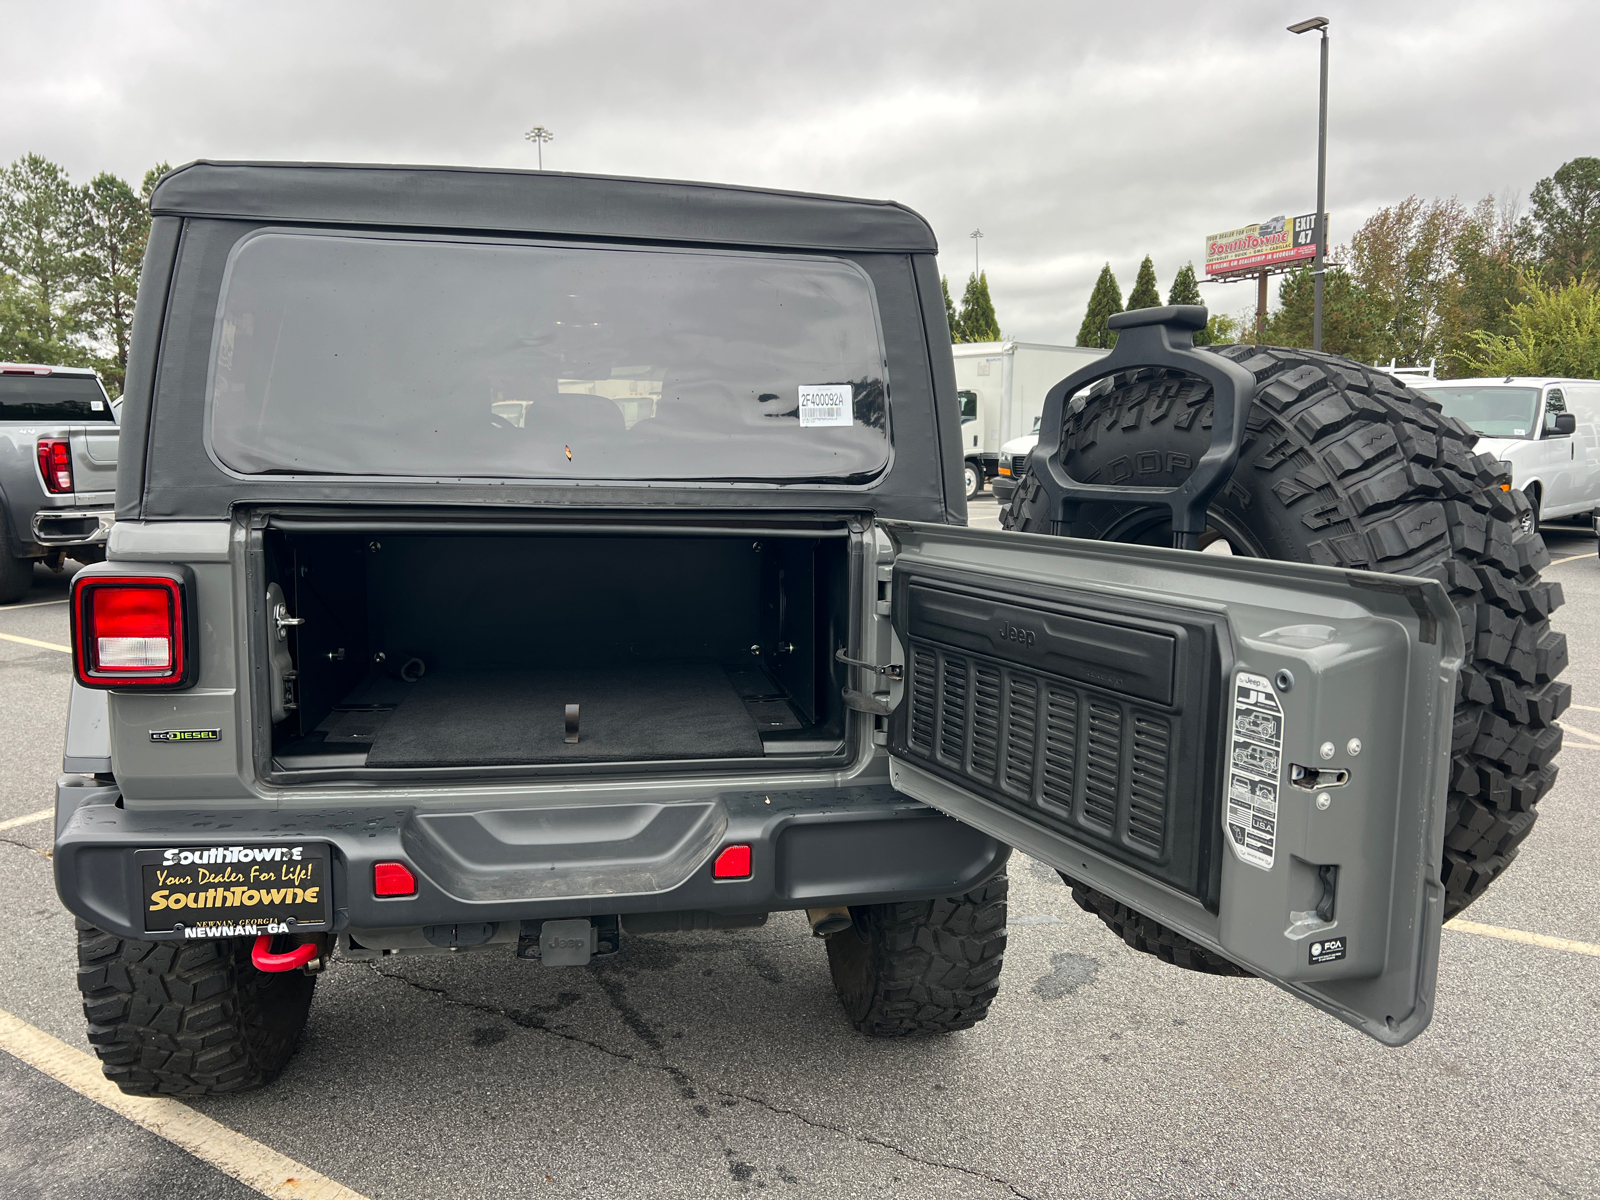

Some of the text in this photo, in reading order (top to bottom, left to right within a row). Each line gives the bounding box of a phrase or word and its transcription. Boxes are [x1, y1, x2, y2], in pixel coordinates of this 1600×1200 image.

[1295, 215, 1316, 231] EXIT
[1219, 230, 1235, 240] DEALER
[1298, 230, 1312, 244] 47
[1206, 255, 1229, 263] CHEVROLET
[1270, 243, 1291, 251] CADILLAC
[1213, 261, 1230, 270] VOLUME
[1239, 254, 1266, 265] DEALERSHIP
[801, 393, 844, 407] 2F400092A
[999, 620, 1036, 649] Jeep
[1245, 677, 1261, 687] Jeep
[1237, 690, 1277, 707] JL
[1252, 819, 1274, 834] USA
[156, 863, 313, 886] Your Dealer For Life!
[239, 917, 278, 926] GEORGIA
[184, 922, 289, 938] NEWNAN, GA
[548, 936, 585, 951] Jeep
[1324, 940, 1342, 950] FCA
